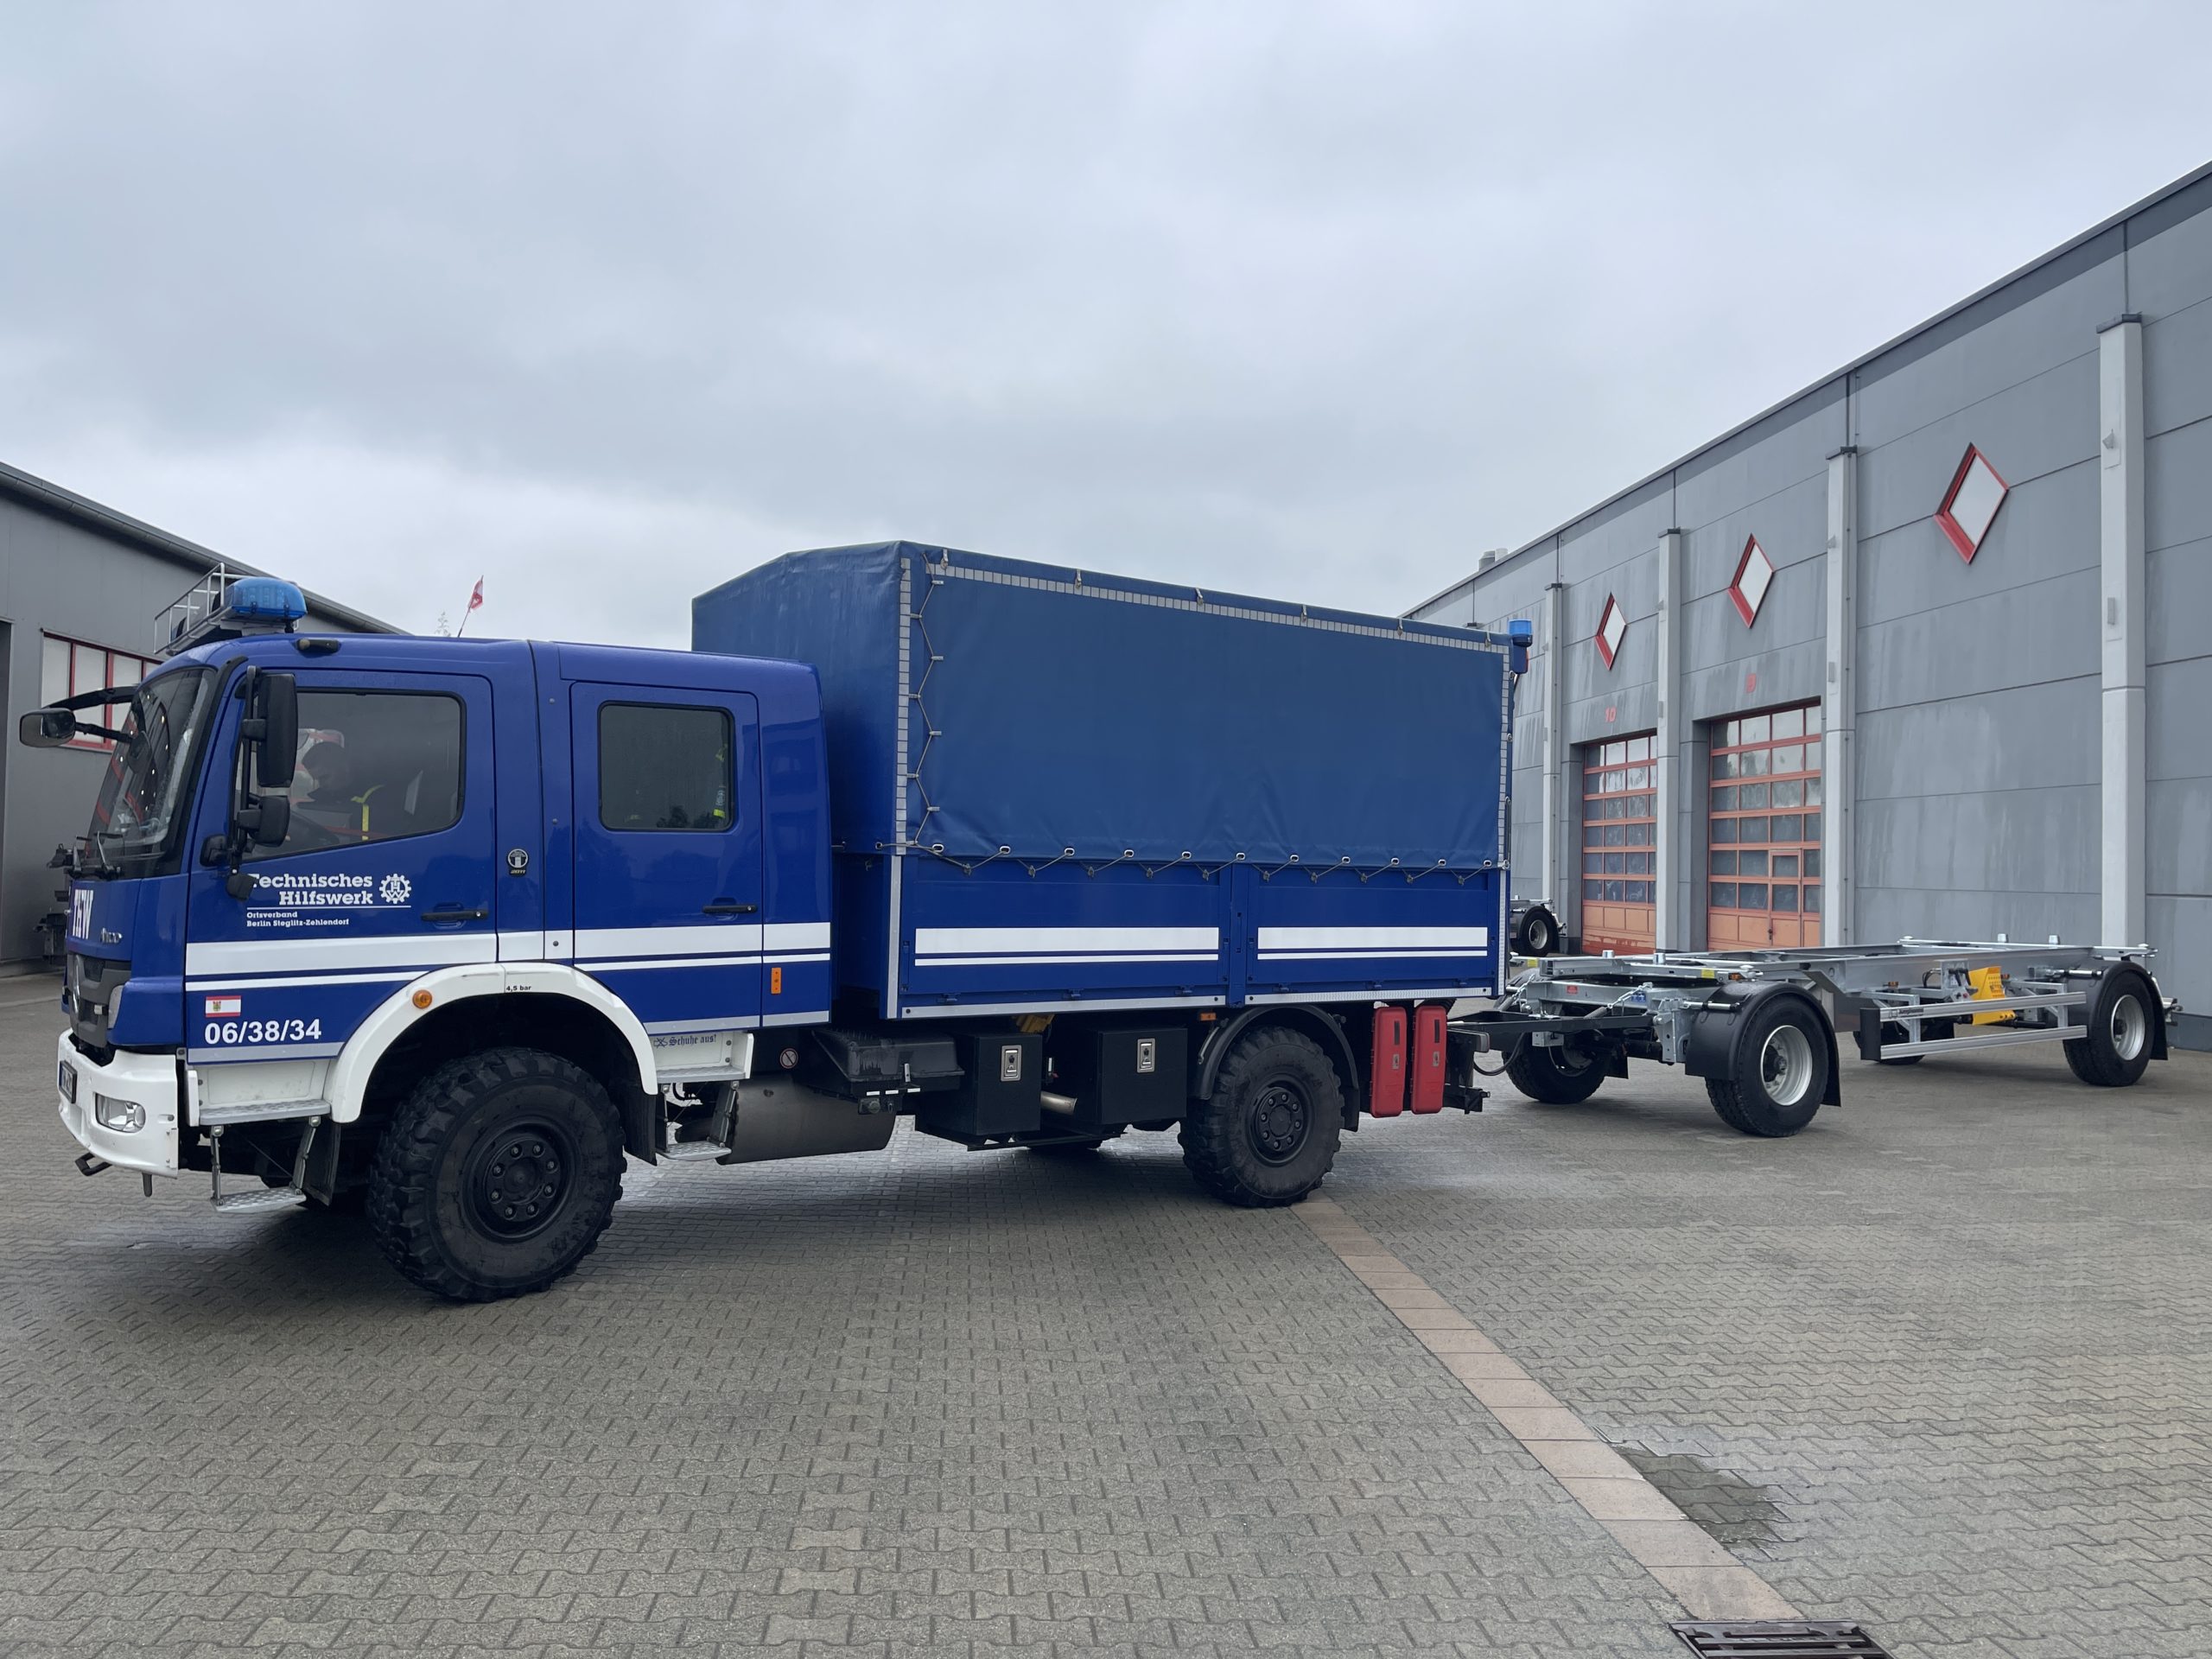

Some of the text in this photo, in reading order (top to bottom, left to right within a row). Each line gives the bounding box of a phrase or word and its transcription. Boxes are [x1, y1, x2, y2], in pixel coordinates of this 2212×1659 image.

[1605, 705, 1617, 723] 10
[278, 890, 374, 906] Hilfswerk
[72, 888, 94, 940] THW
[273, 918, 349, 928] Steglitz-Zehlendorf
[204, 1018, 322, 1045] 06/38/34
[669, 1033, 716, 1047] Schuhe aus!
